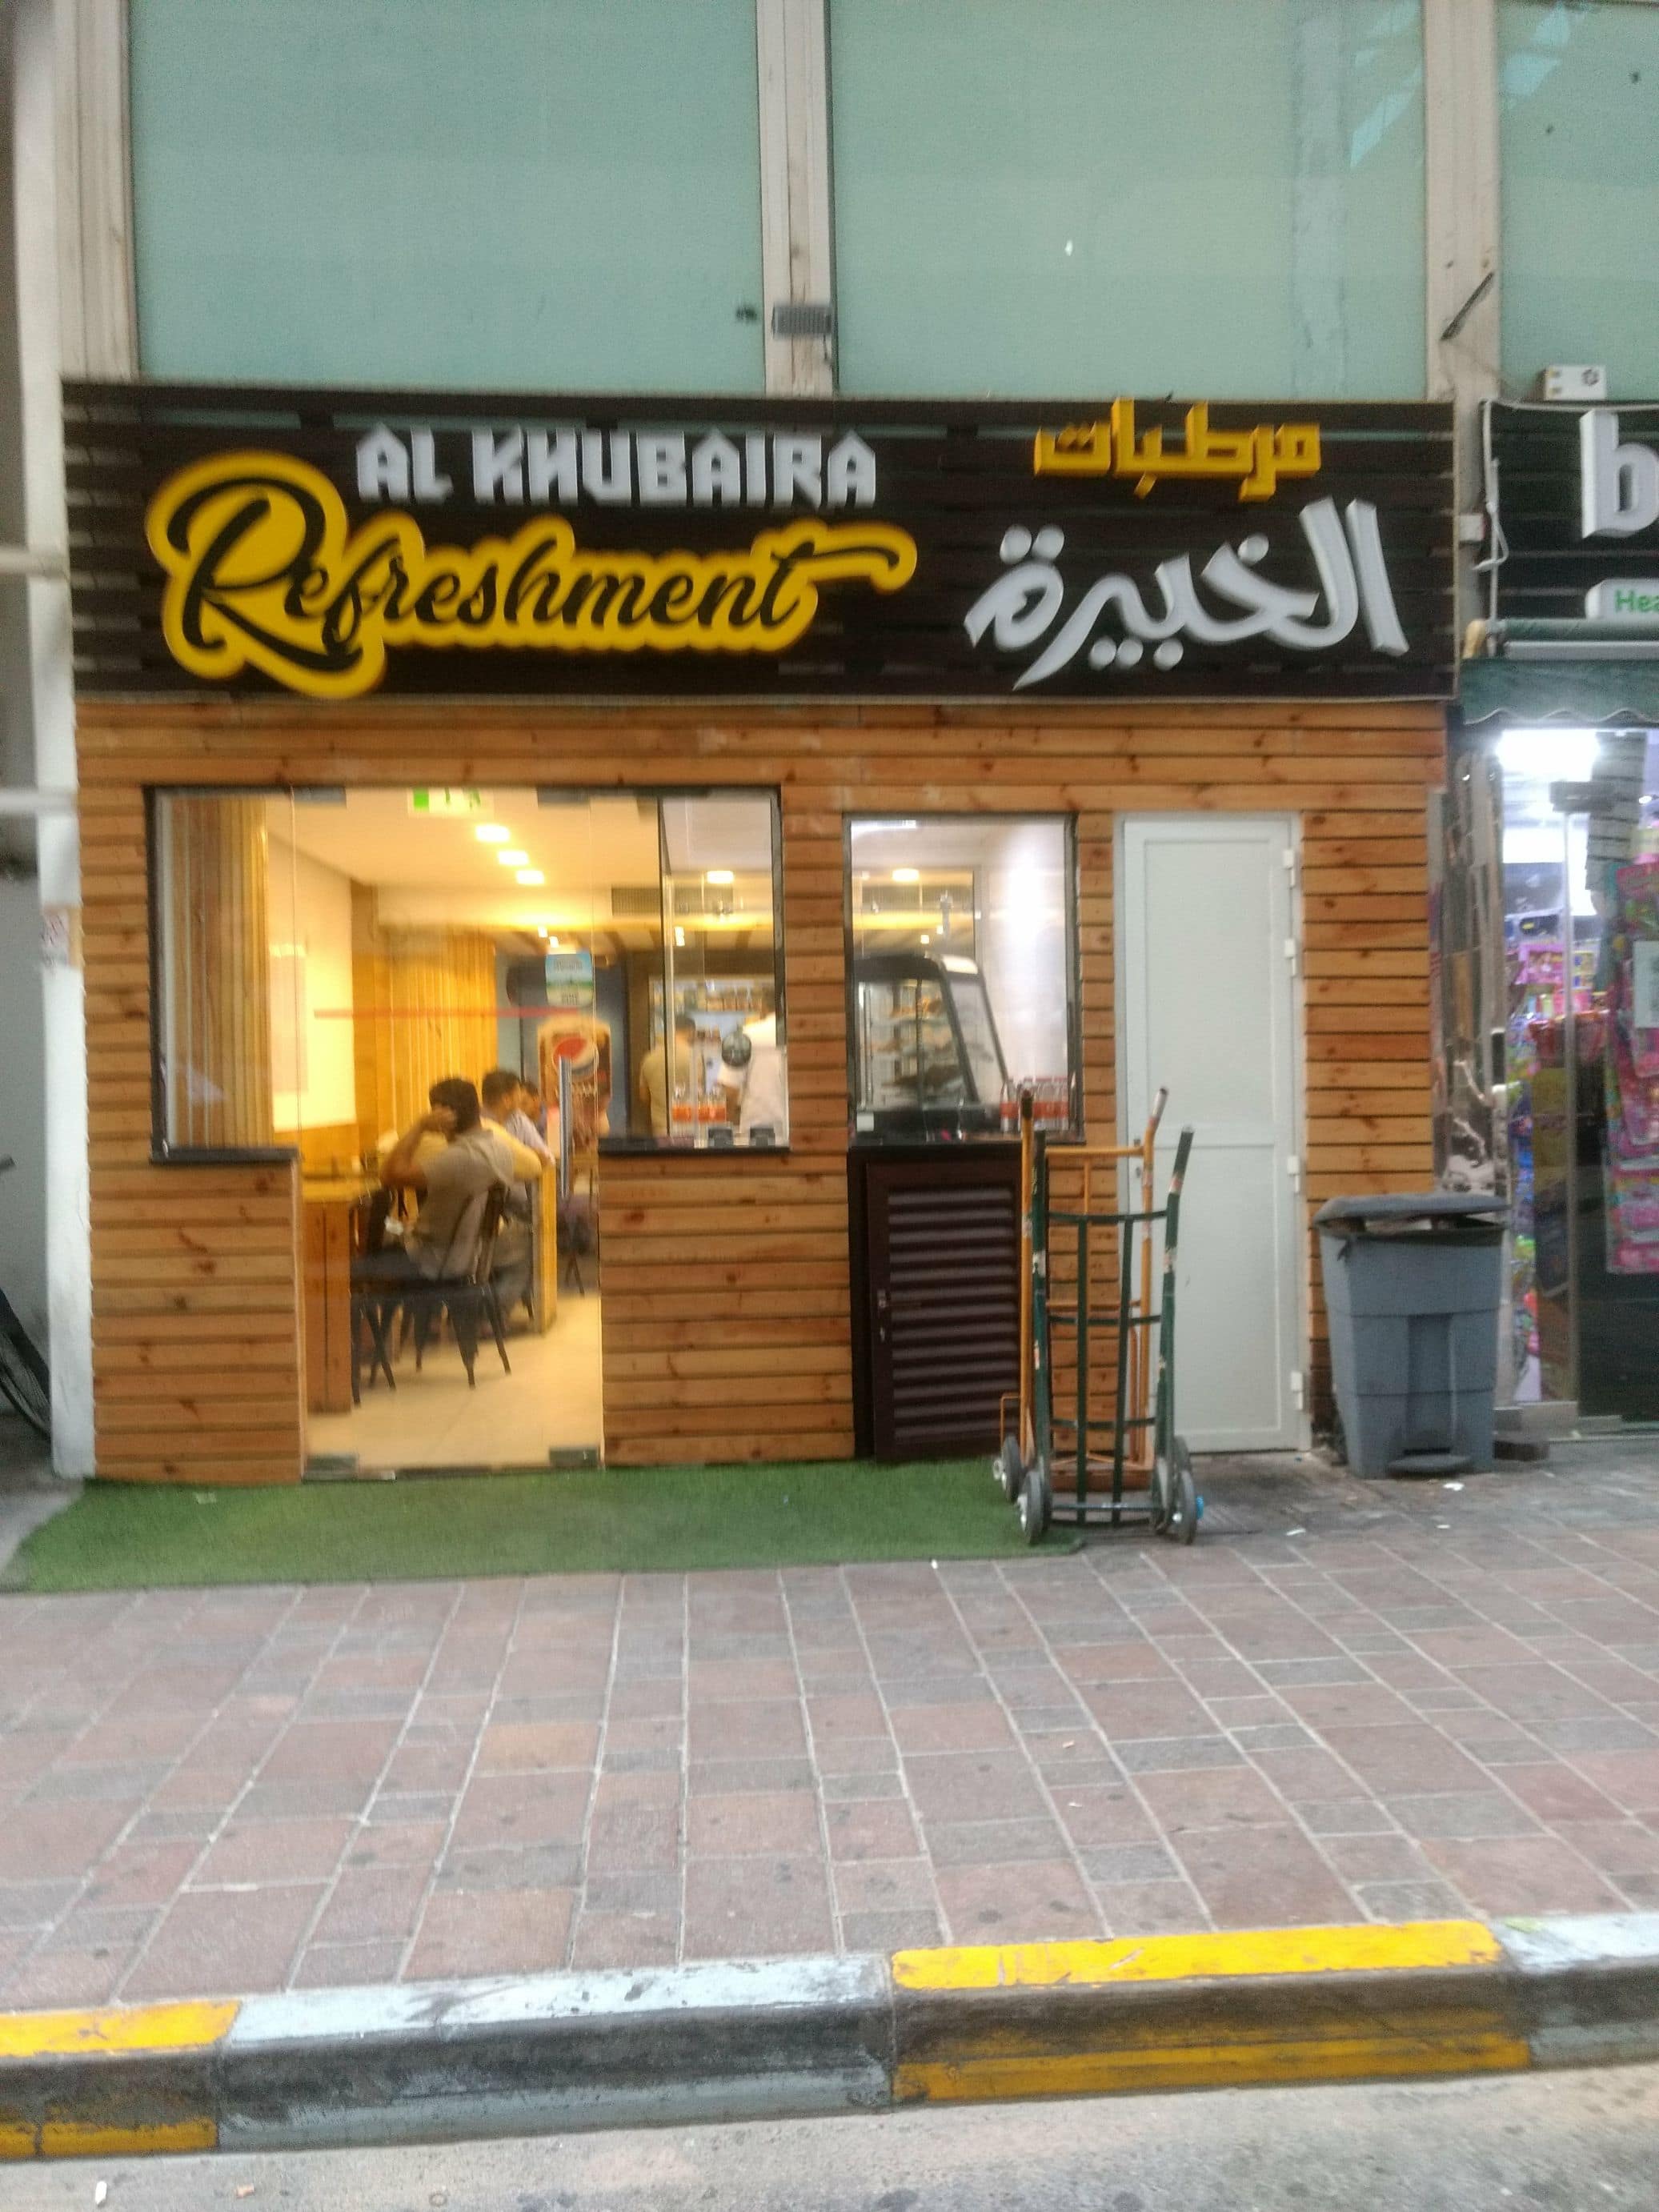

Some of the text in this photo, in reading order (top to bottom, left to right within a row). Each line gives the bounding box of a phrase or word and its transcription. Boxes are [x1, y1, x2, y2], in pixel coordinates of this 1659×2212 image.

[355, 422, 877, 507] AL KHUBAIRA
[1033, 399, 1321, 502] مرطبات
[166, 475, 900, 671] Refreshment
[964, 496, 1409, 691] الخبيرة
